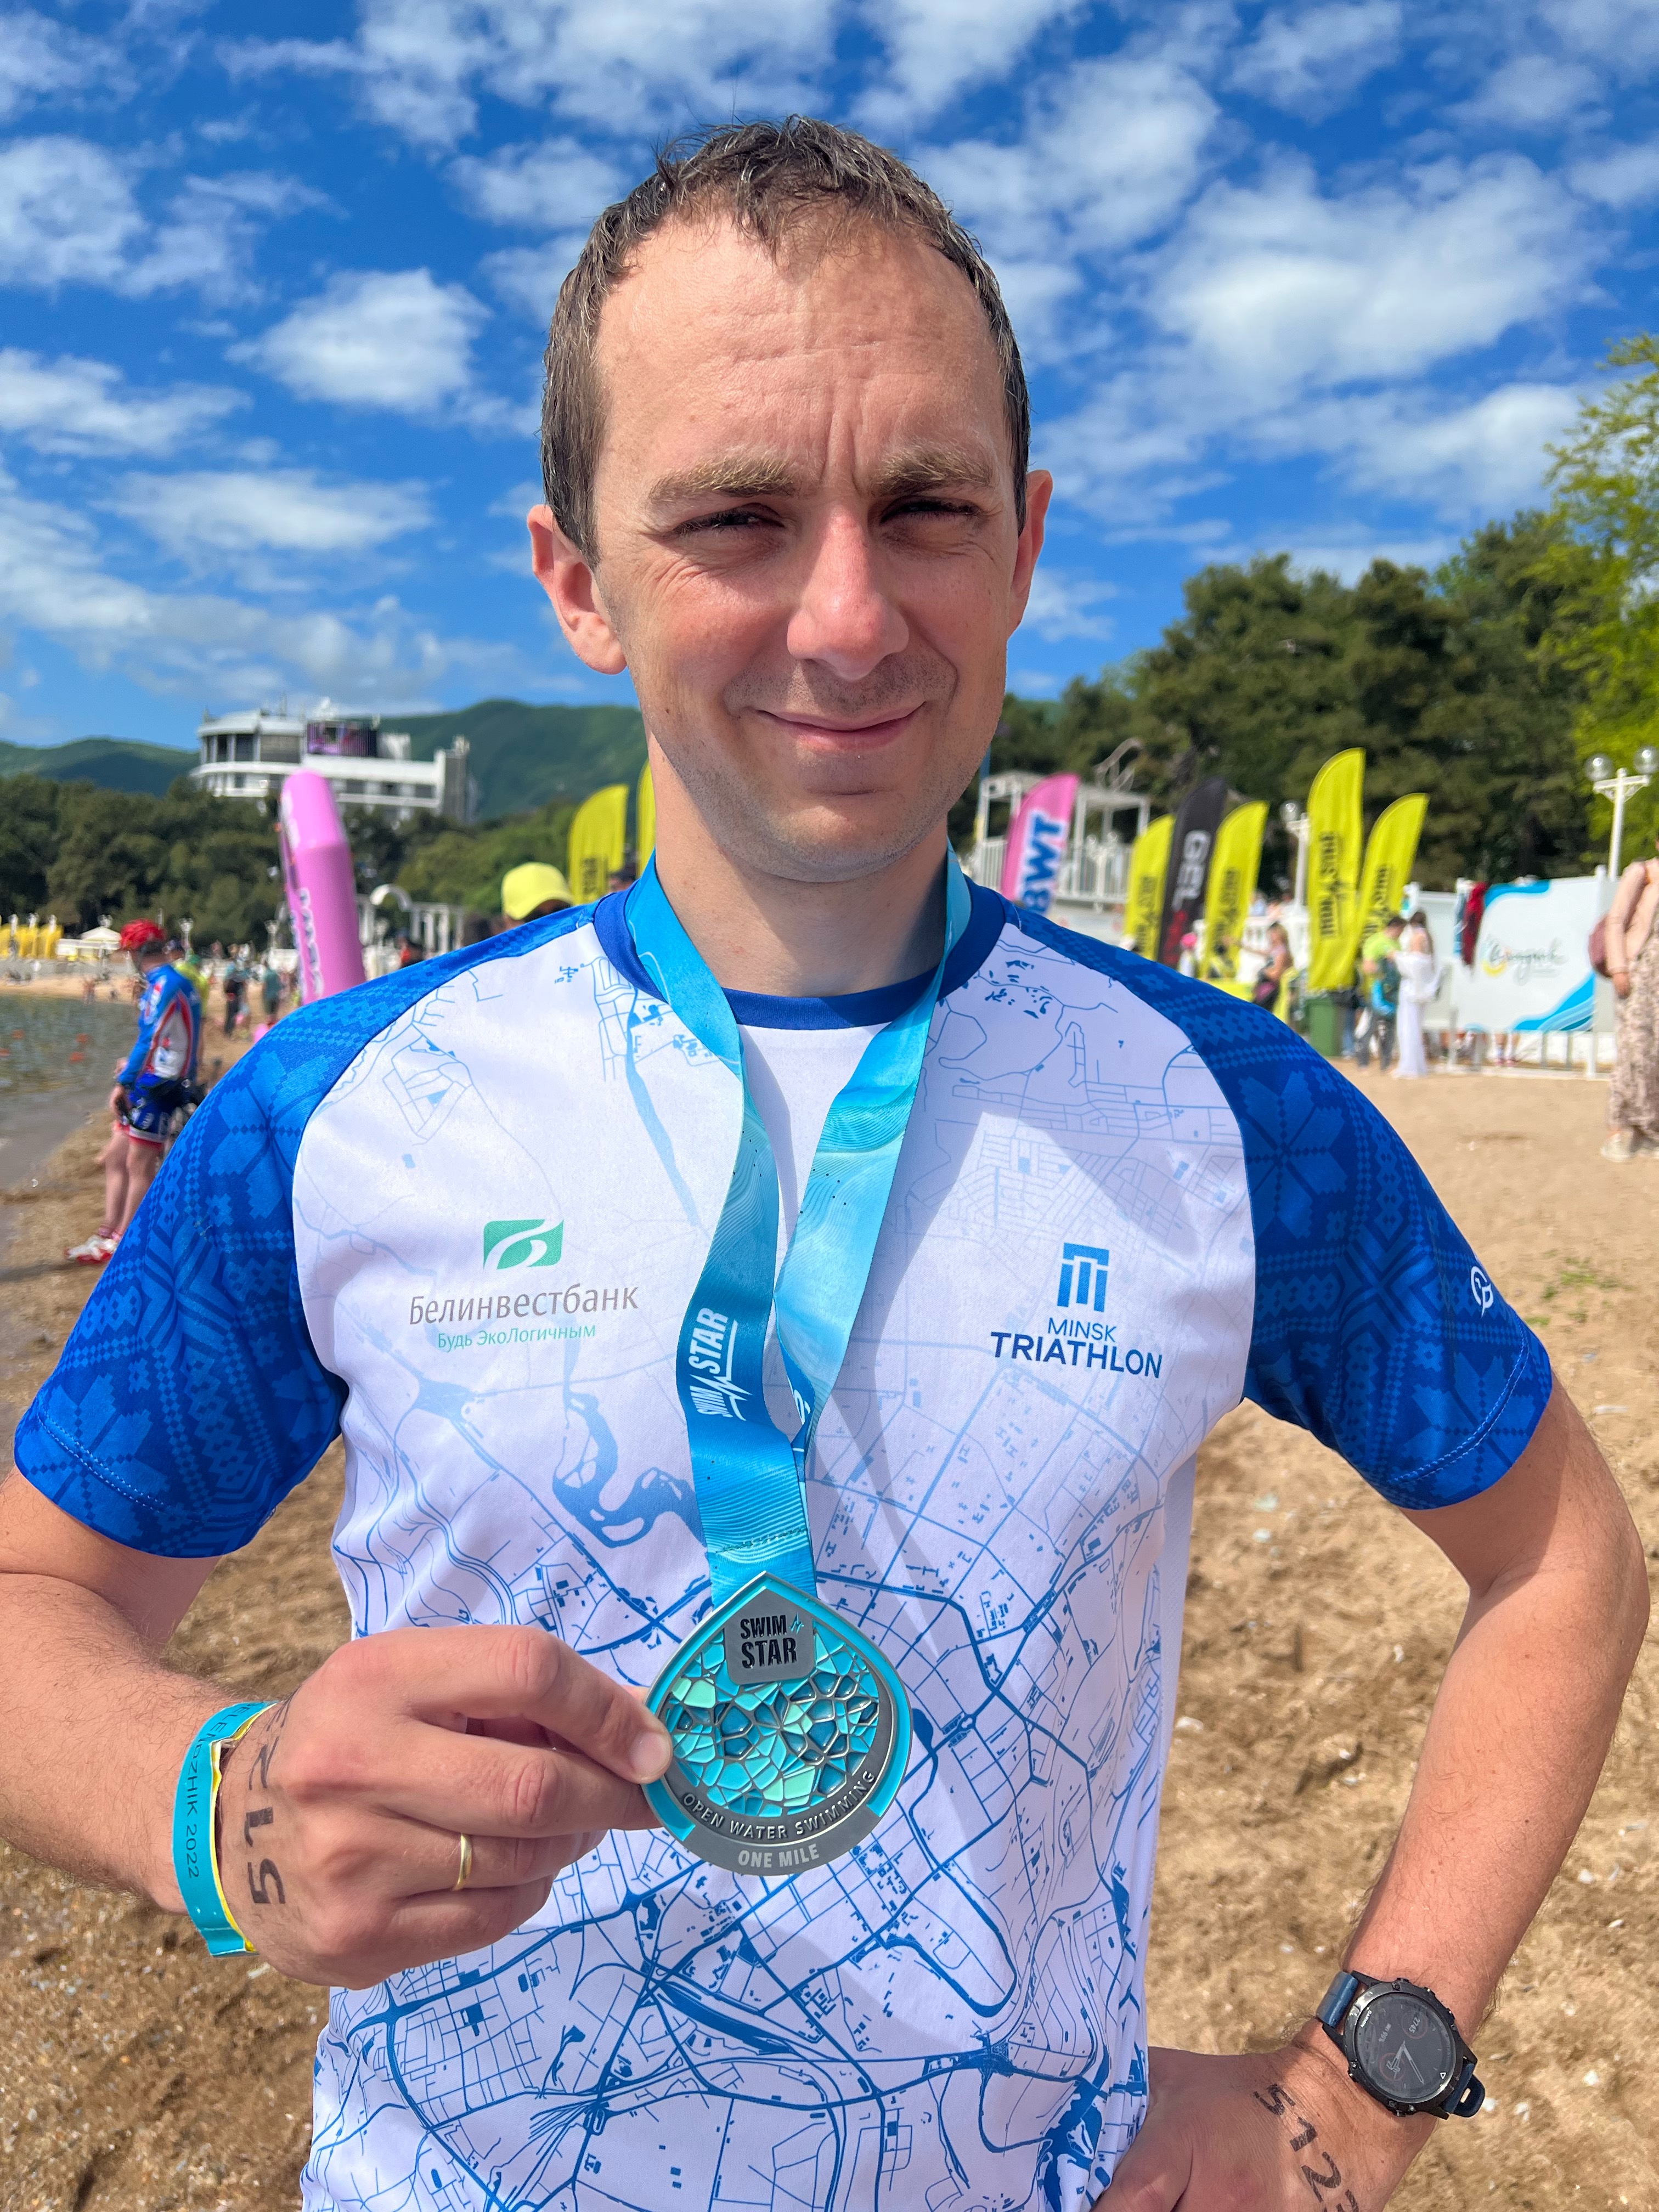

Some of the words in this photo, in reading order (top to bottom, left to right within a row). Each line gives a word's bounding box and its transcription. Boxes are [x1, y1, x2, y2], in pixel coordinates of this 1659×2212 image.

[410, 1283, 639, 1325] Белинвестбанк
[437, 1332, 472, 1352] Будь
[688, 1307, 729, 1374] STAR
[1047, 1317, 1117, 1342] MINSK
[990, 1331, 1163, 1379] TRIATHLON
[740, 1614, 787, 1639] SWIM
[741, 1637, 797, 1669] STAR
[682, 1792, 723, 1829] OPEN
[730, 1819, 788, 1839] WATER
[794, 1770, 876, 1835] SWIMMING
[186, 1824, 199, 1878] 2022
[738, 1850, 772, 1868] ONE
[778, 1844, 820, 1867] MILE
